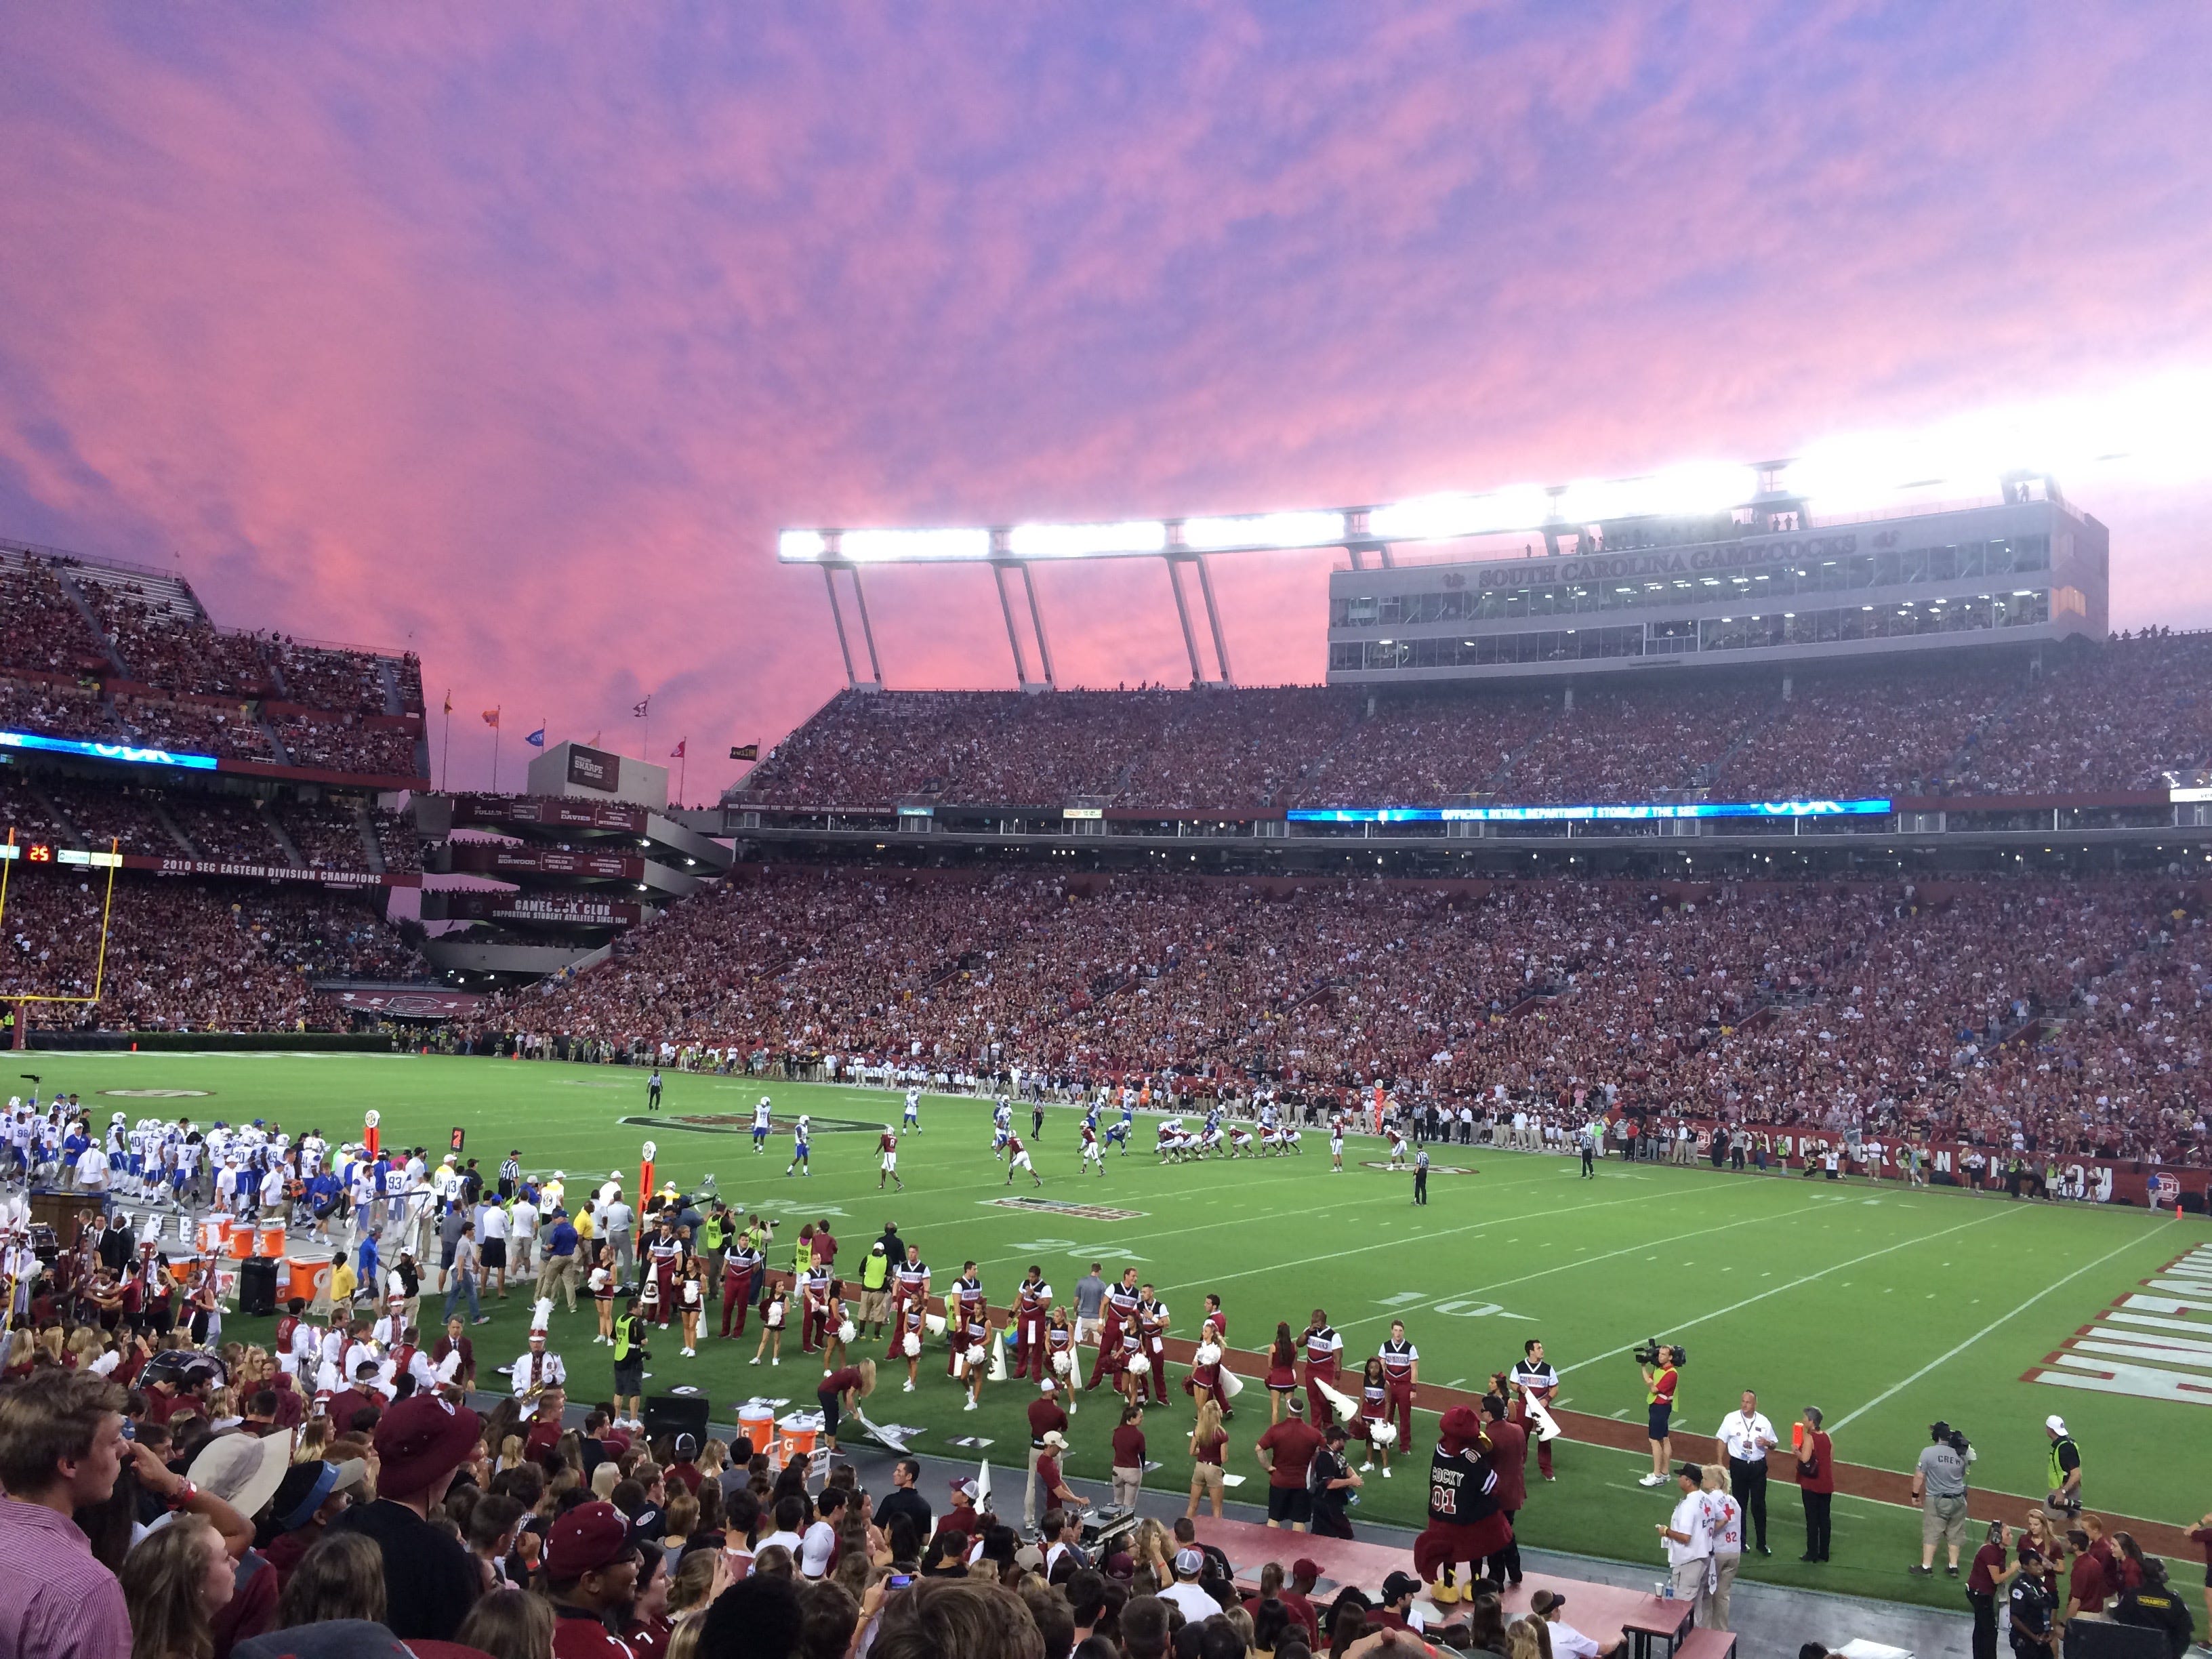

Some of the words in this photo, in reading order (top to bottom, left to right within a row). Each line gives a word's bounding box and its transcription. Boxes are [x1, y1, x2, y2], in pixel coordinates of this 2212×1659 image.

[1479, 565, 1557, 588] SOUTH
[1561, 552, 1687, 581] CAROLINA
[1689, 533, 1857, 571] GAMECOCKS
[574, 760, 604, 775] SHARPE
[560, 814, 592, 822] DAVIES
[30, 846, 49, 861] 25
[162, 859, 192, 871] 2010
[196, 861, 216, 873] SEC
[220, 863, 265, 877] EASTERN
[267, 867, 316, 880] DIVISION
[320, 871, 382, 884] CHAMPIONS
[514, 899, 579, 914] GAMECK
[583, 903, 611, 916] CLUB
[493, 909, 531, 919] SUPPORTING
[533, 912, 563, 921] STUDENT
[564, 913, 595, 923] ATHLETES
[596, 915, 614, 924] SINCE
[17, 1129, 28, 1138] 98
[452, 1130, 462, 1146] 2
[130, 1136, 141, 1147] 40
[147, 1141, 153, 1154] 5
[184, 1149, 192, 1162] 7
[388, 1176, 403, 1190] 93
[447, 1180, 457, 1193] 13
[1004, 1238, 1133, 1259] 20
[276, 1288, 285, 1298] G
[1367, 1292, 1504, 1317] 10
[741, 1427, 750, 1437] G
[783, 1437, 794, 1451] G
[1938, 1455, 1961, 1465] CREW
[1432, 1467, 1465, 1487] COCKY
[1431, 1485, 1456, 1515] 01
[1725, 1531, 1737, 1543] 82
[2139, 1597, 2169, 1606] PARAMEDIC
[634, 1631, 654, 1645] 7
